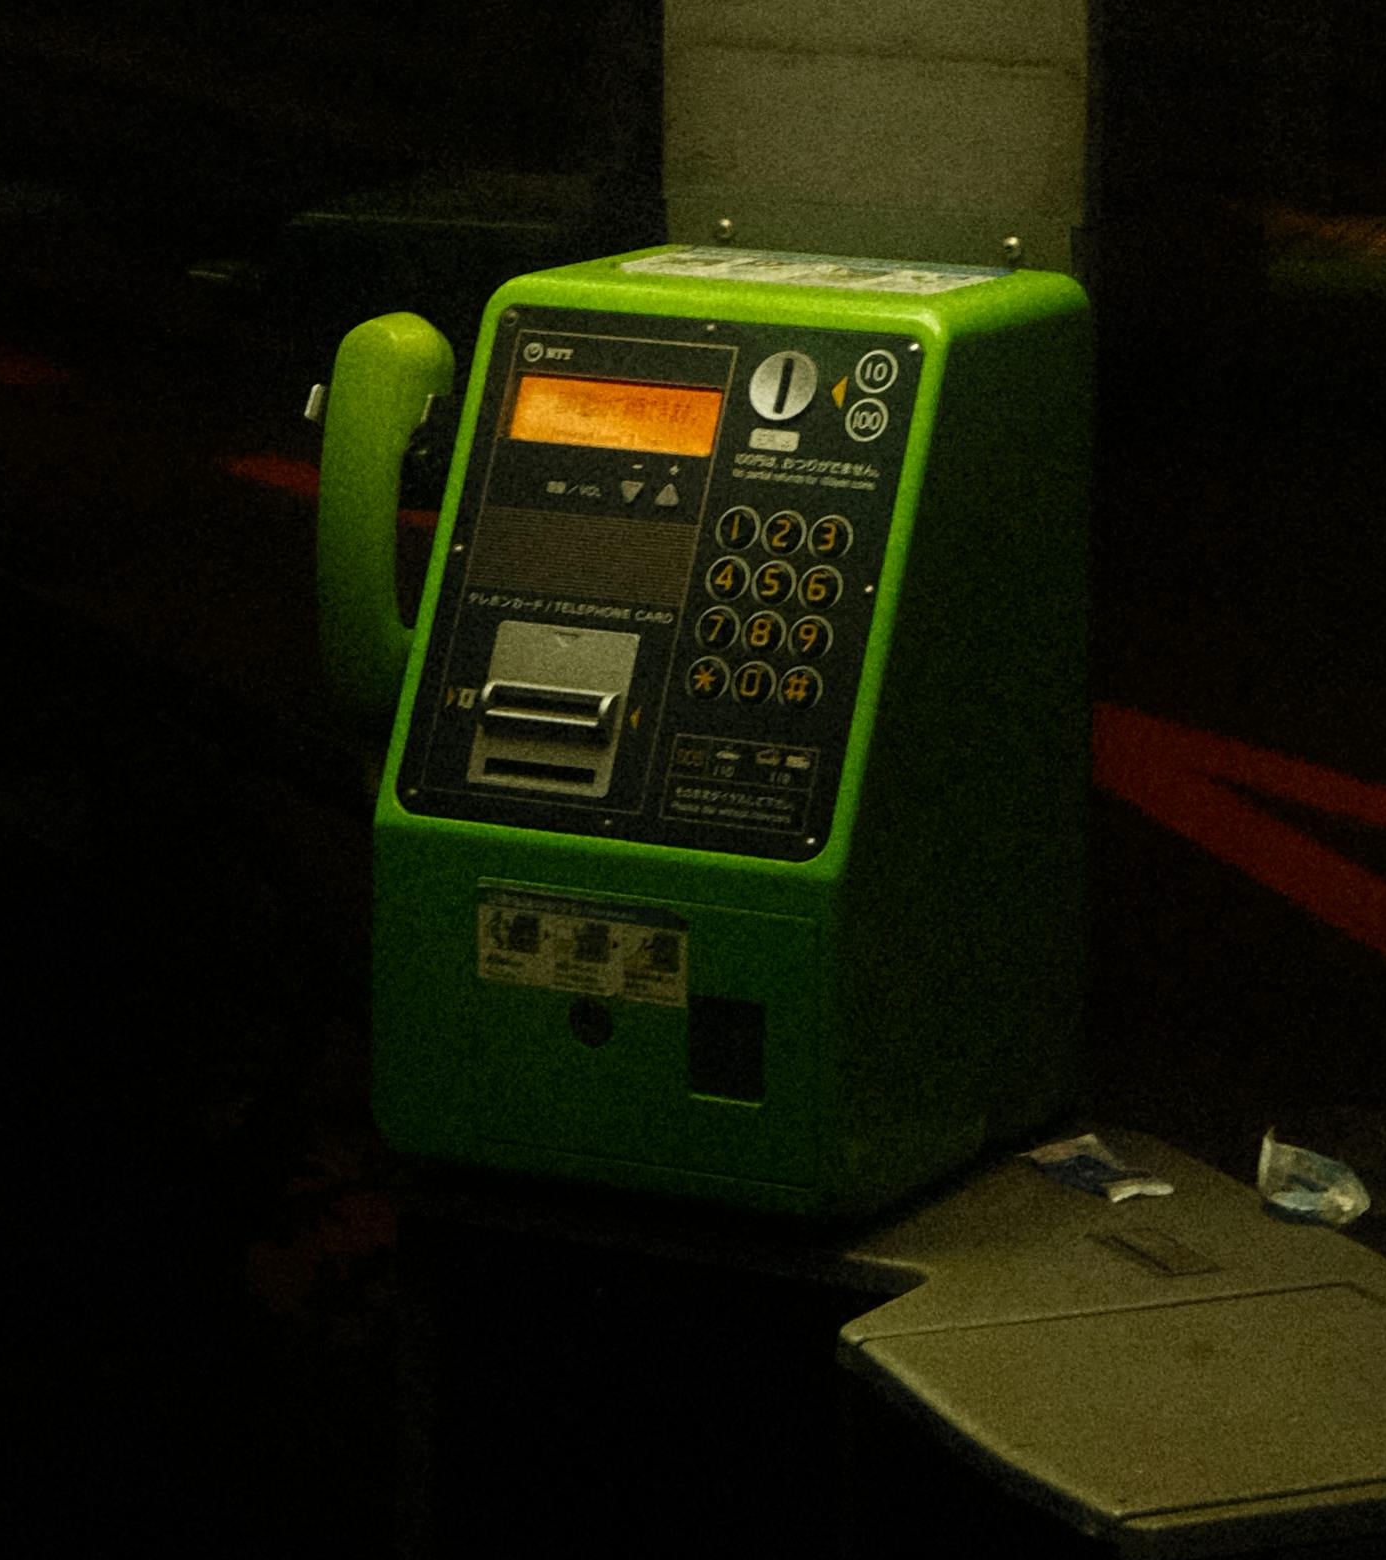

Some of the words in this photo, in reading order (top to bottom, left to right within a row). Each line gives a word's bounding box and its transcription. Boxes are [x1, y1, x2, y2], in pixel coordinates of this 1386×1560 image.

[864, 361, 888, 381] 10
[852, 410, 882, 431] 100
[730, 514, 741, 541] 1
[772, 518, 792, 548] 2
[817, 522, 838, 551] 3
[714, 562, 735, 591] 4
[760, 567, 782, 597] 5
[806, 571, 831, 602] 6
[554, 600, 632, 620] TELEPHONE
[635, 610, 676, 624] CARD
[708, 614, 725, 642] 7
[748, 617, 773, 647] 8
[797, 623, 819, 652] 9
[740, 667, 764, 697] 0
